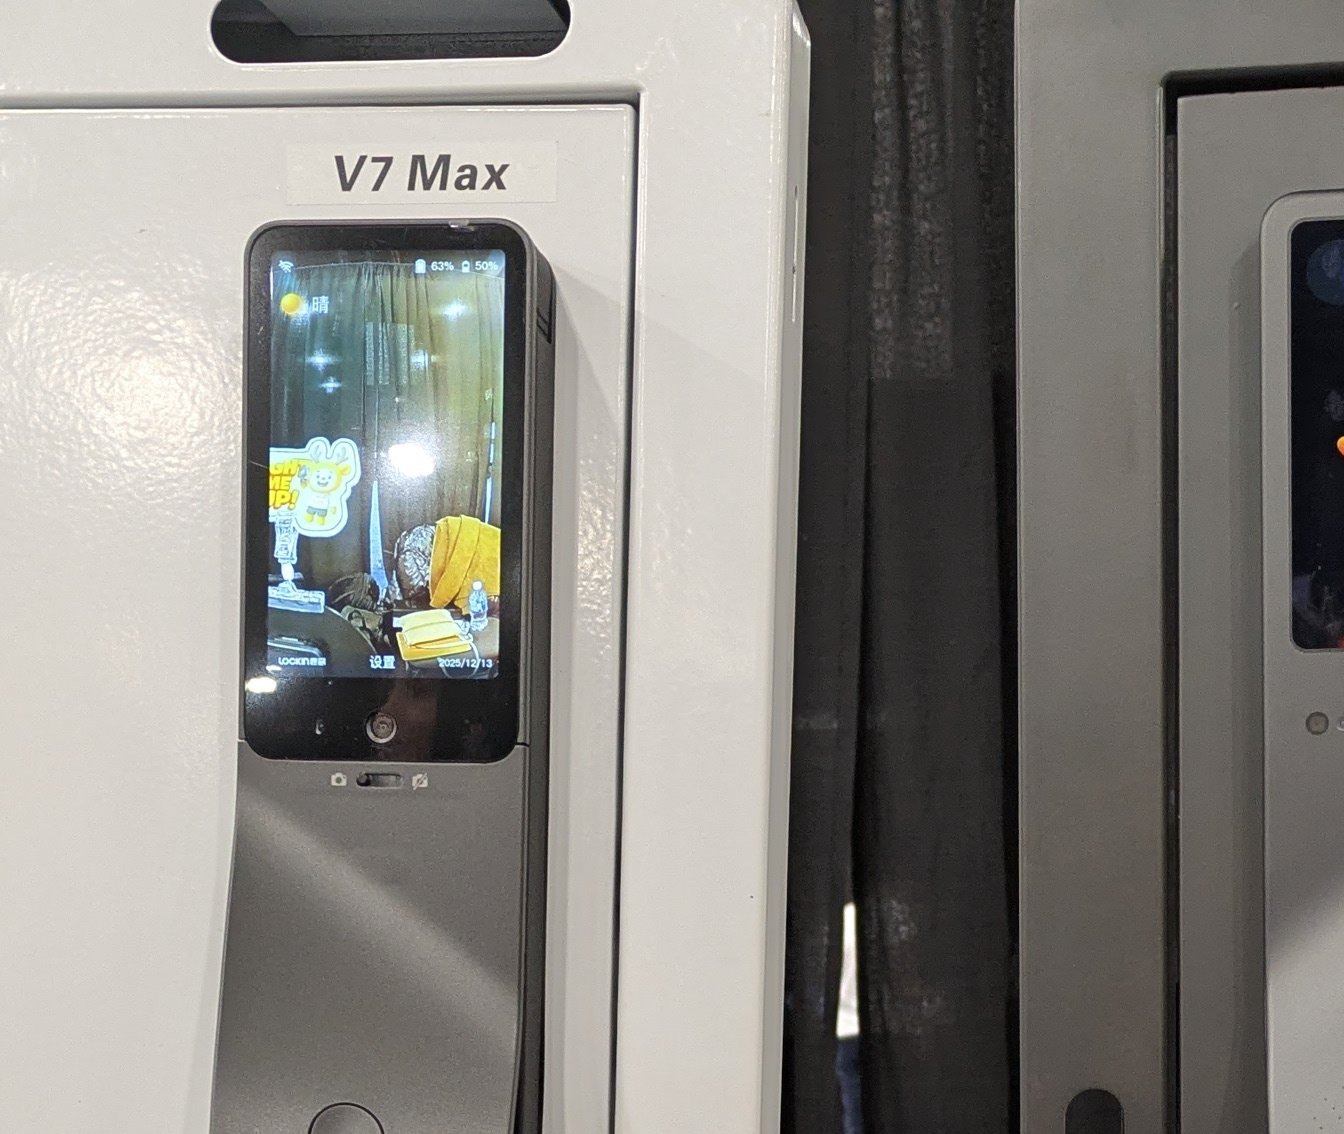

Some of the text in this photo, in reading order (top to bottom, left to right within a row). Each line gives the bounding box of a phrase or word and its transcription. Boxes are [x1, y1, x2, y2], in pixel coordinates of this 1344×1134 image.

[334, 154, 510, 192] V7 Max
[430, 260, 454, 272] 63%
[312, 296, 330, 315] 晴
[369, 655, 396, 669] 设置
[438, 658, 493, 669] 2025/12/13
